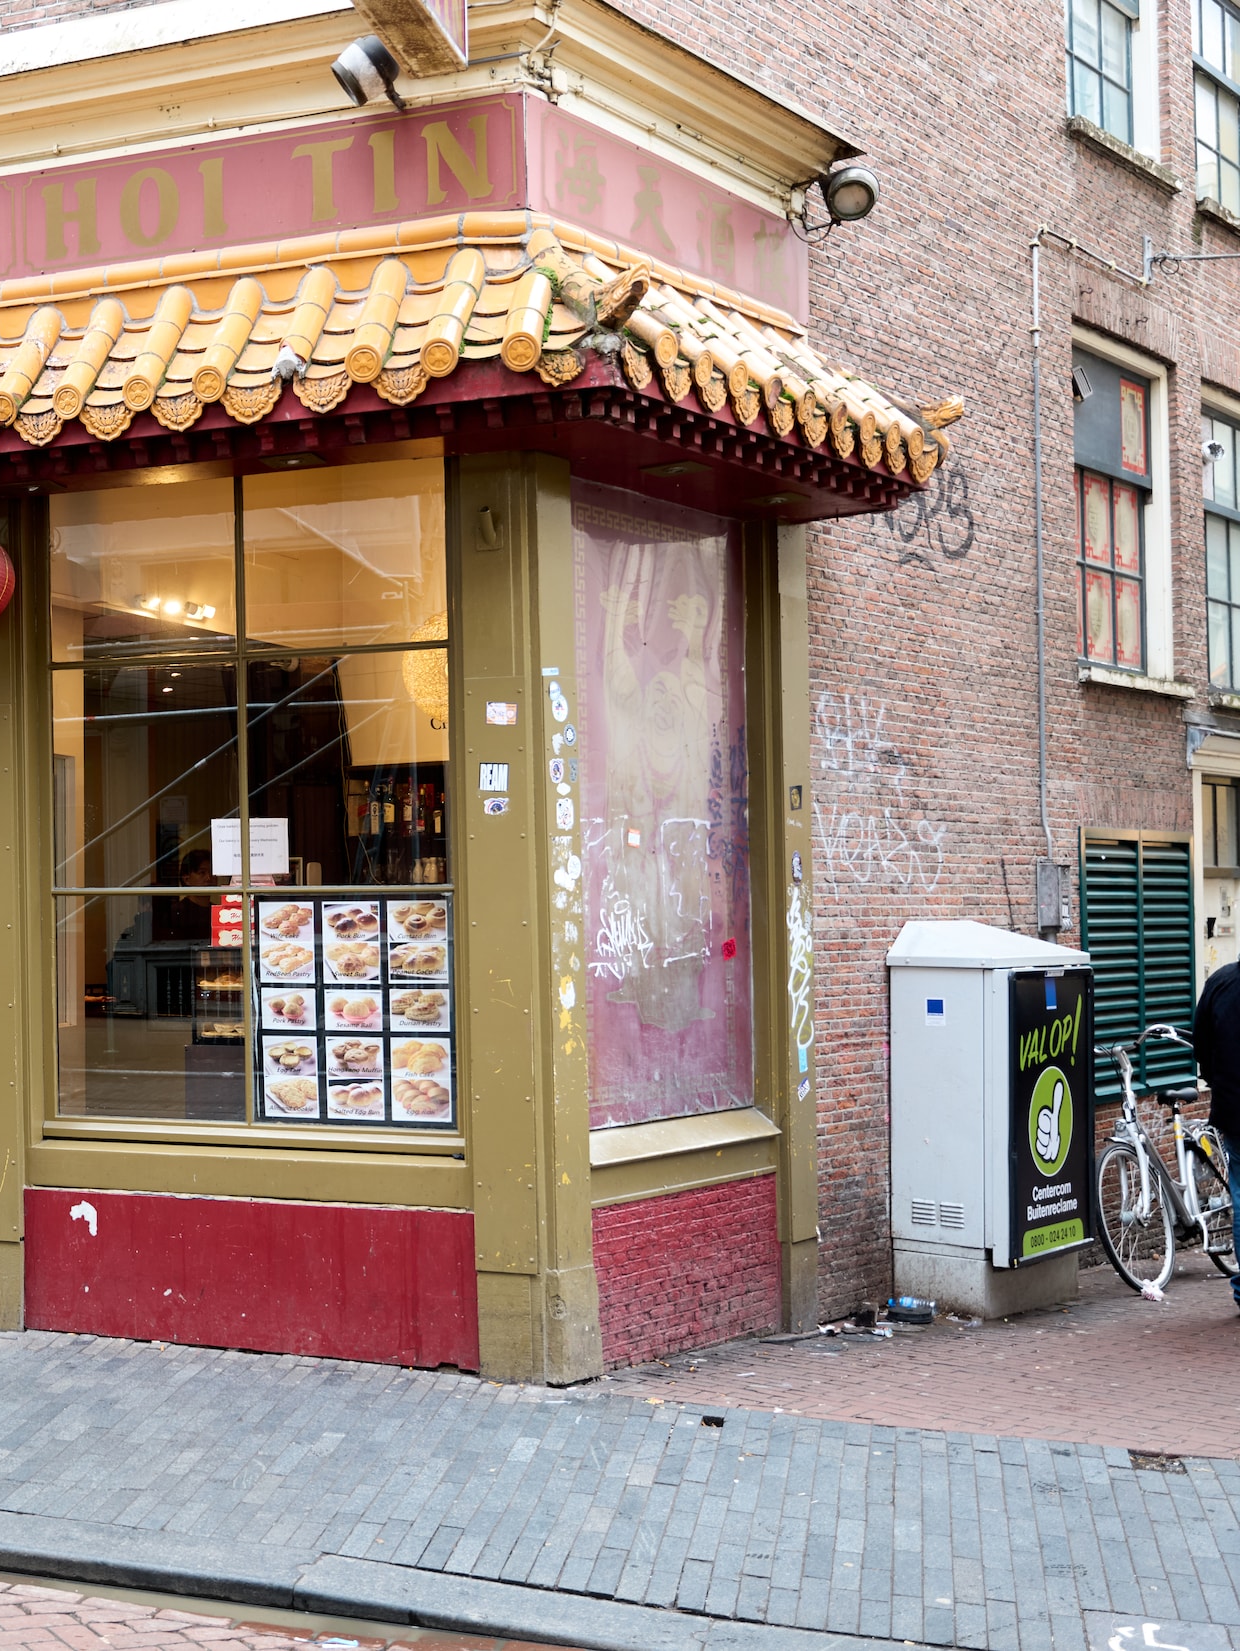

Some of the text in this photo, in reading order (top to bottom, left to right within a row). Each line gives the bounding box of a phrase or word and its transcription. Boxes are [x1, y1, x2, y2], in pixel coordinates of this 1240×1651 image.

[41, 113, 494, 262] HOI TIN
[554, 126, 791, 304] 海天酒樓
[287, 1017, 305, 1025] Pastry
[1032, 1182, 1072, 1202] Centercom
[1026, 1198, 1078, 1221] Buitenreclame
[1030, 1233, 1045, 1248] 0800
[1049, 1230, 1060, 1243] 024
[1061, 1228, 1068, 1240] 24
[1069, 1225, 1076, 1238] 10
